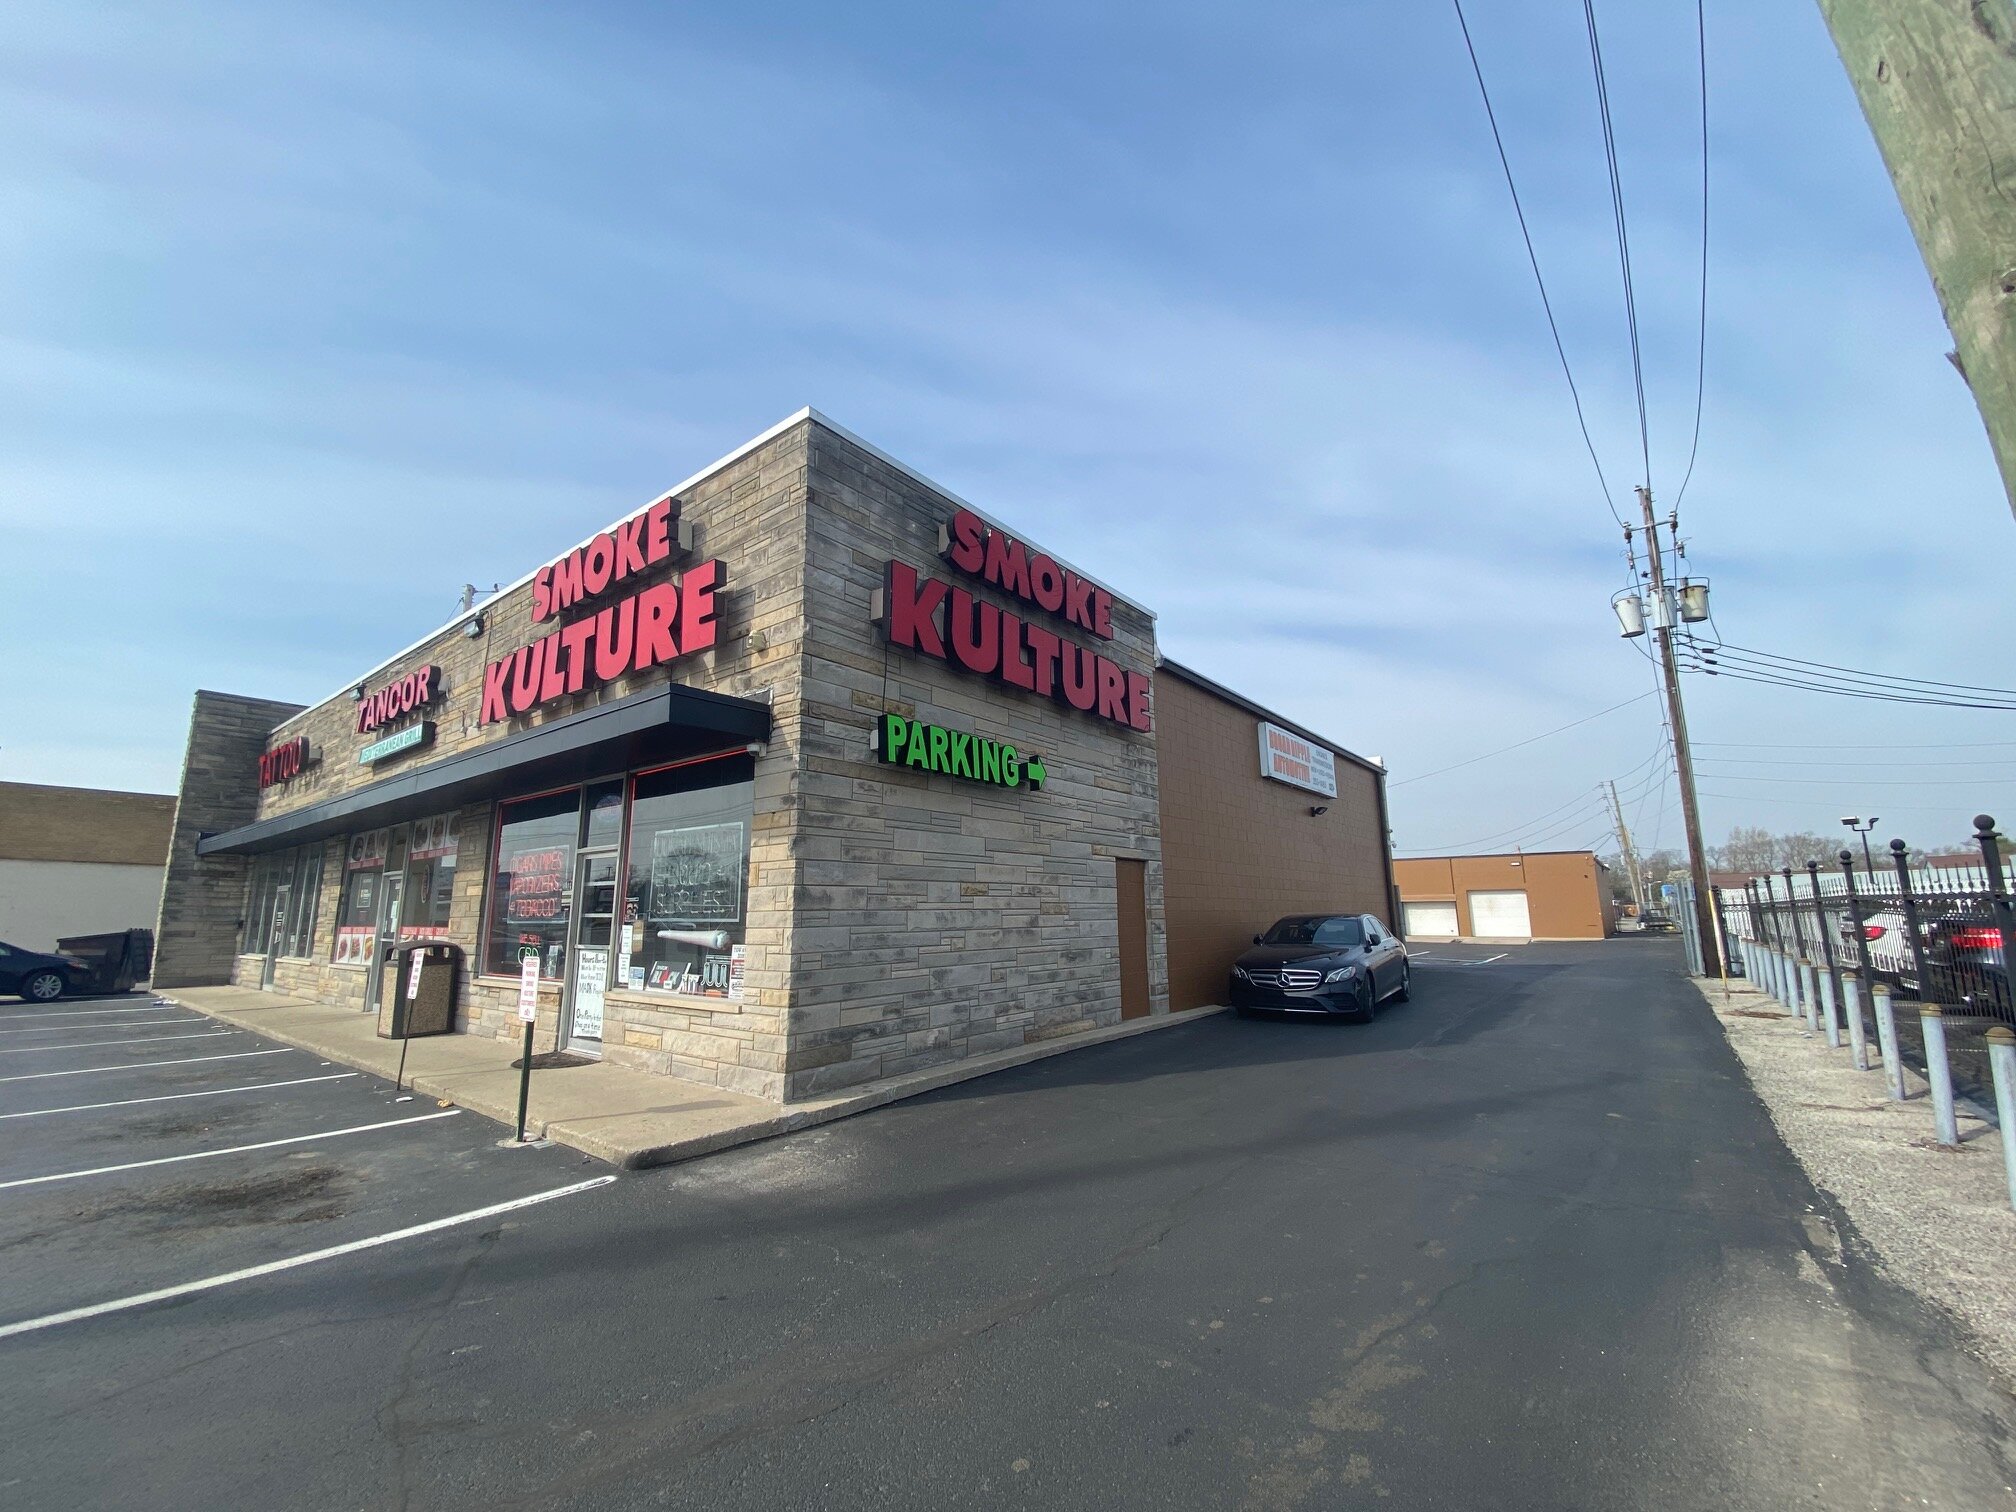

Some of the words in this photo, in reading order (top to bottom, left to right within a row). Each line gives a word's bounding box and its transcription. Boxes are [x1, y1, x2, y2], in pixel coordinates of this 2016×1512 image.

[531, 497, 671, 623] SMOKE
[951, 508, 1113, 641] SMOKE
[480, 559, 717, 726] KULTURE
[890, 560, 1150, 732] KULTURE
[258, 736, 302, 788] TATTOO
[887, 713, 1019, 787] PARKING
[516, 898, 556, 917] TOBACCO
